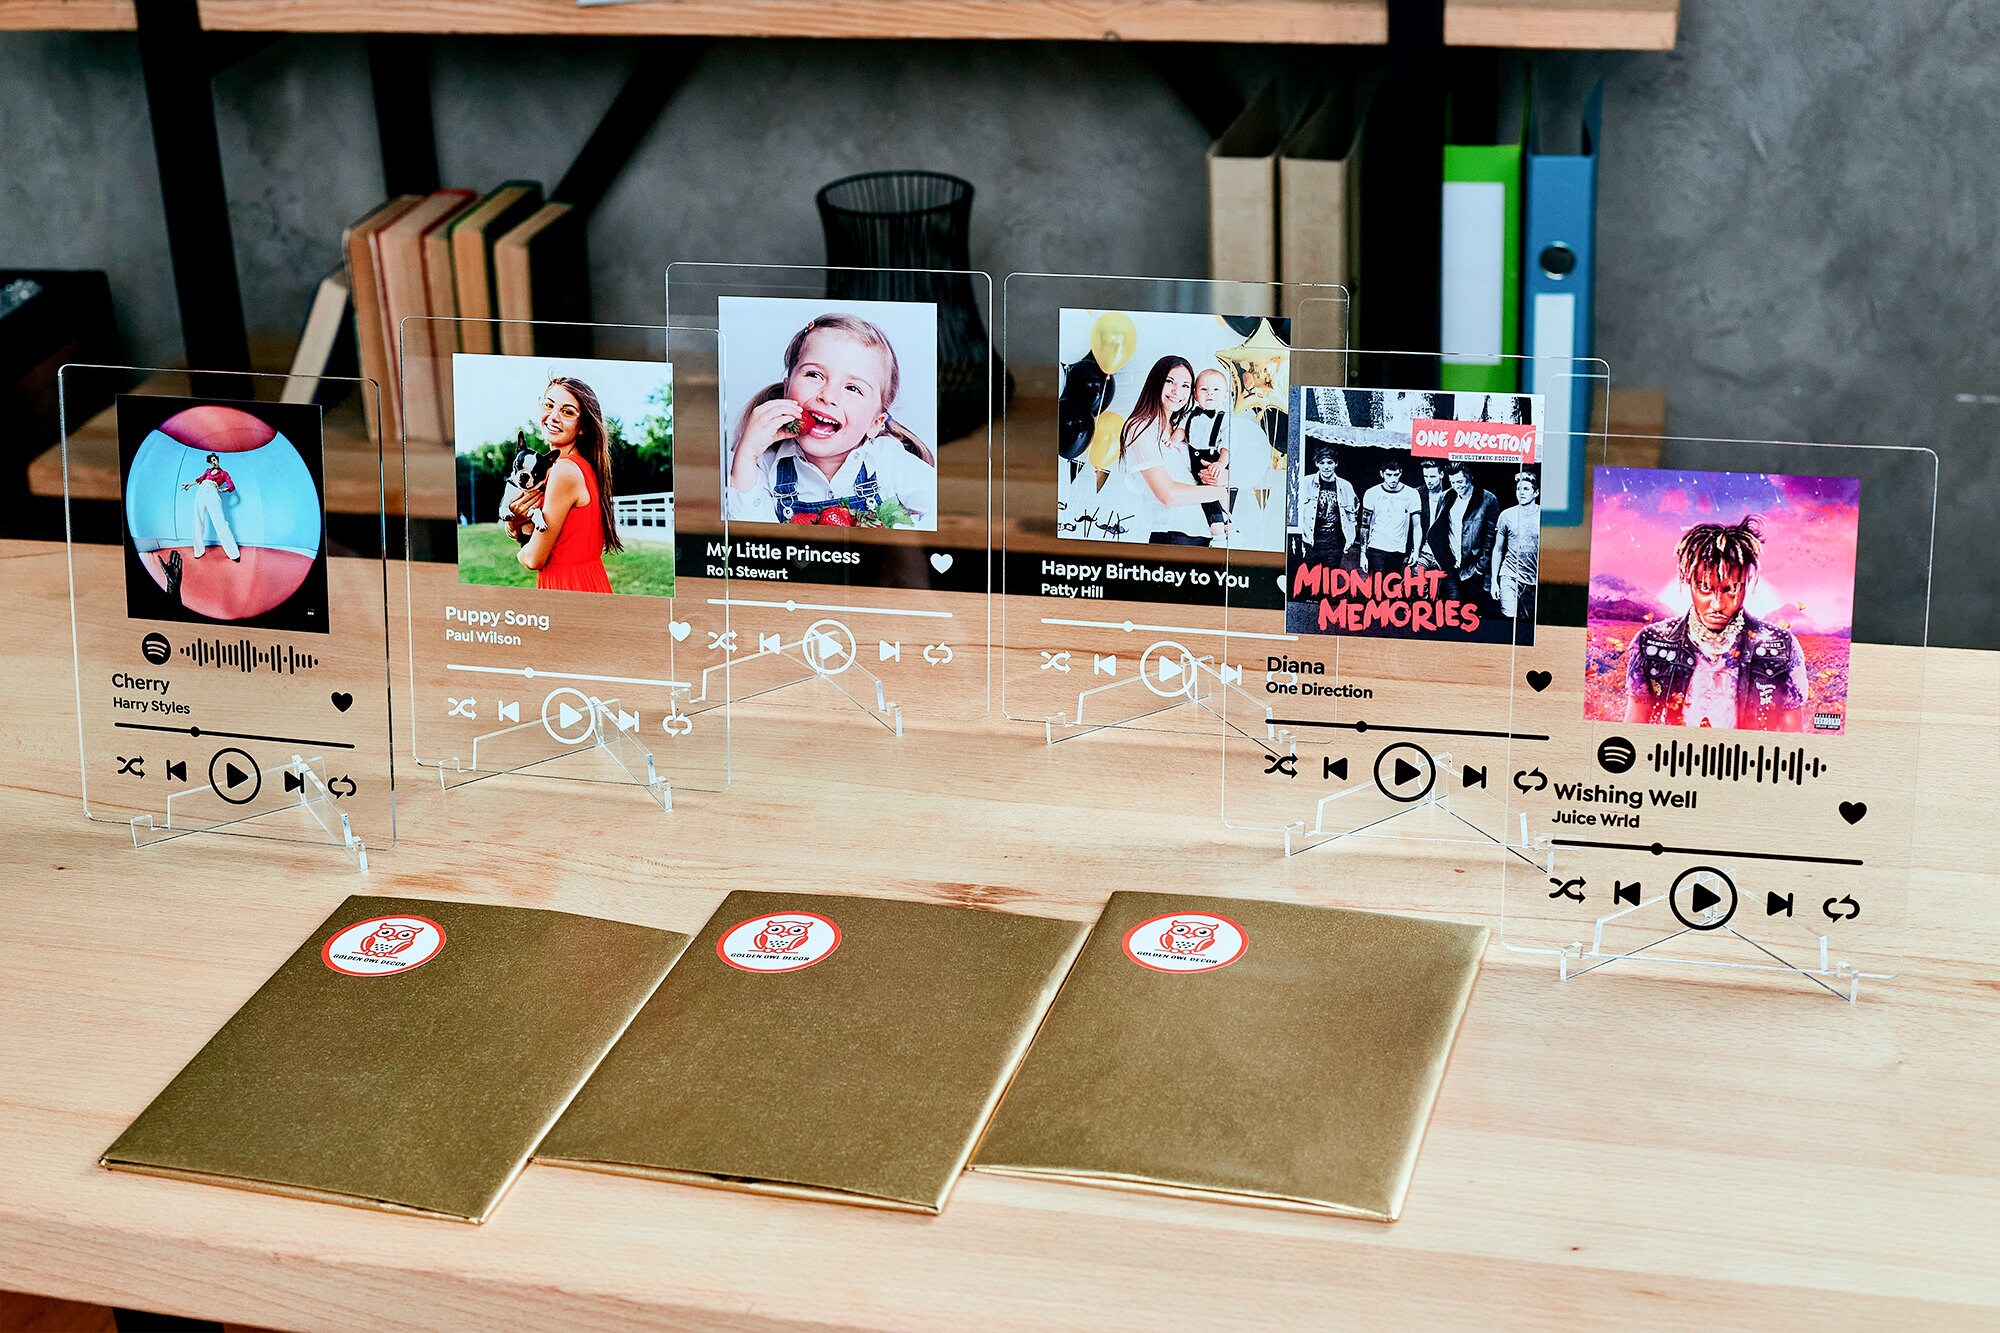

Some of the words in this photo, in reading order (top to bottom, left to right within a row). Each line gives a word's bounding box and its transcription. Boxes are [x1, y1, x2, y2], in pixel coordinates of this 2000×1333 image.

[1415, 429, 1448, 447] ONE
[1453, 430, 1532, 453] DIRECTION
[706, 541, 732, 561] My
[735, 542, 782, 561] Little
[786, 544, 860, 565] Princess
[706, 564, 733, 577] Ron
[735, 565, 788, 580] Stewart
[1041, 560, 1102, 581] Happy
[1106, 562, 1186, 586] Birthday
[1189, 569, 1211, 586] to
[1214, 571, 1250, 589] You
[1292, 562, 1448, 601] MIDNIGHT
[1041, 583, 1078, 600] Patty
[1080, 585, 1104, 599] Hill
[445, 605, 501, 627] Puppy
[504, 609, 550, 631] Song
[1317, 598, 1481, 633] MEMORIES
[445, 628, 475, 643] Paul
[477, 630, 522, 646] Wilson
[1267, 655, 1325, 675] Diana
[111, 673, 170, 695] Cherry
[1265, 681, 1299, 695] One
[1301, 683, 1374, 699] Direction
[113, 697, 149, 712] Harry
[151, 700, 191, 715] Styles
[1553, 783, 1643, 809] Wishing
[1648, 790, 1698, 809] Well
[1551, 810, 1598, 826] Juice
[1600, 813, 1641, 829] Wrld
